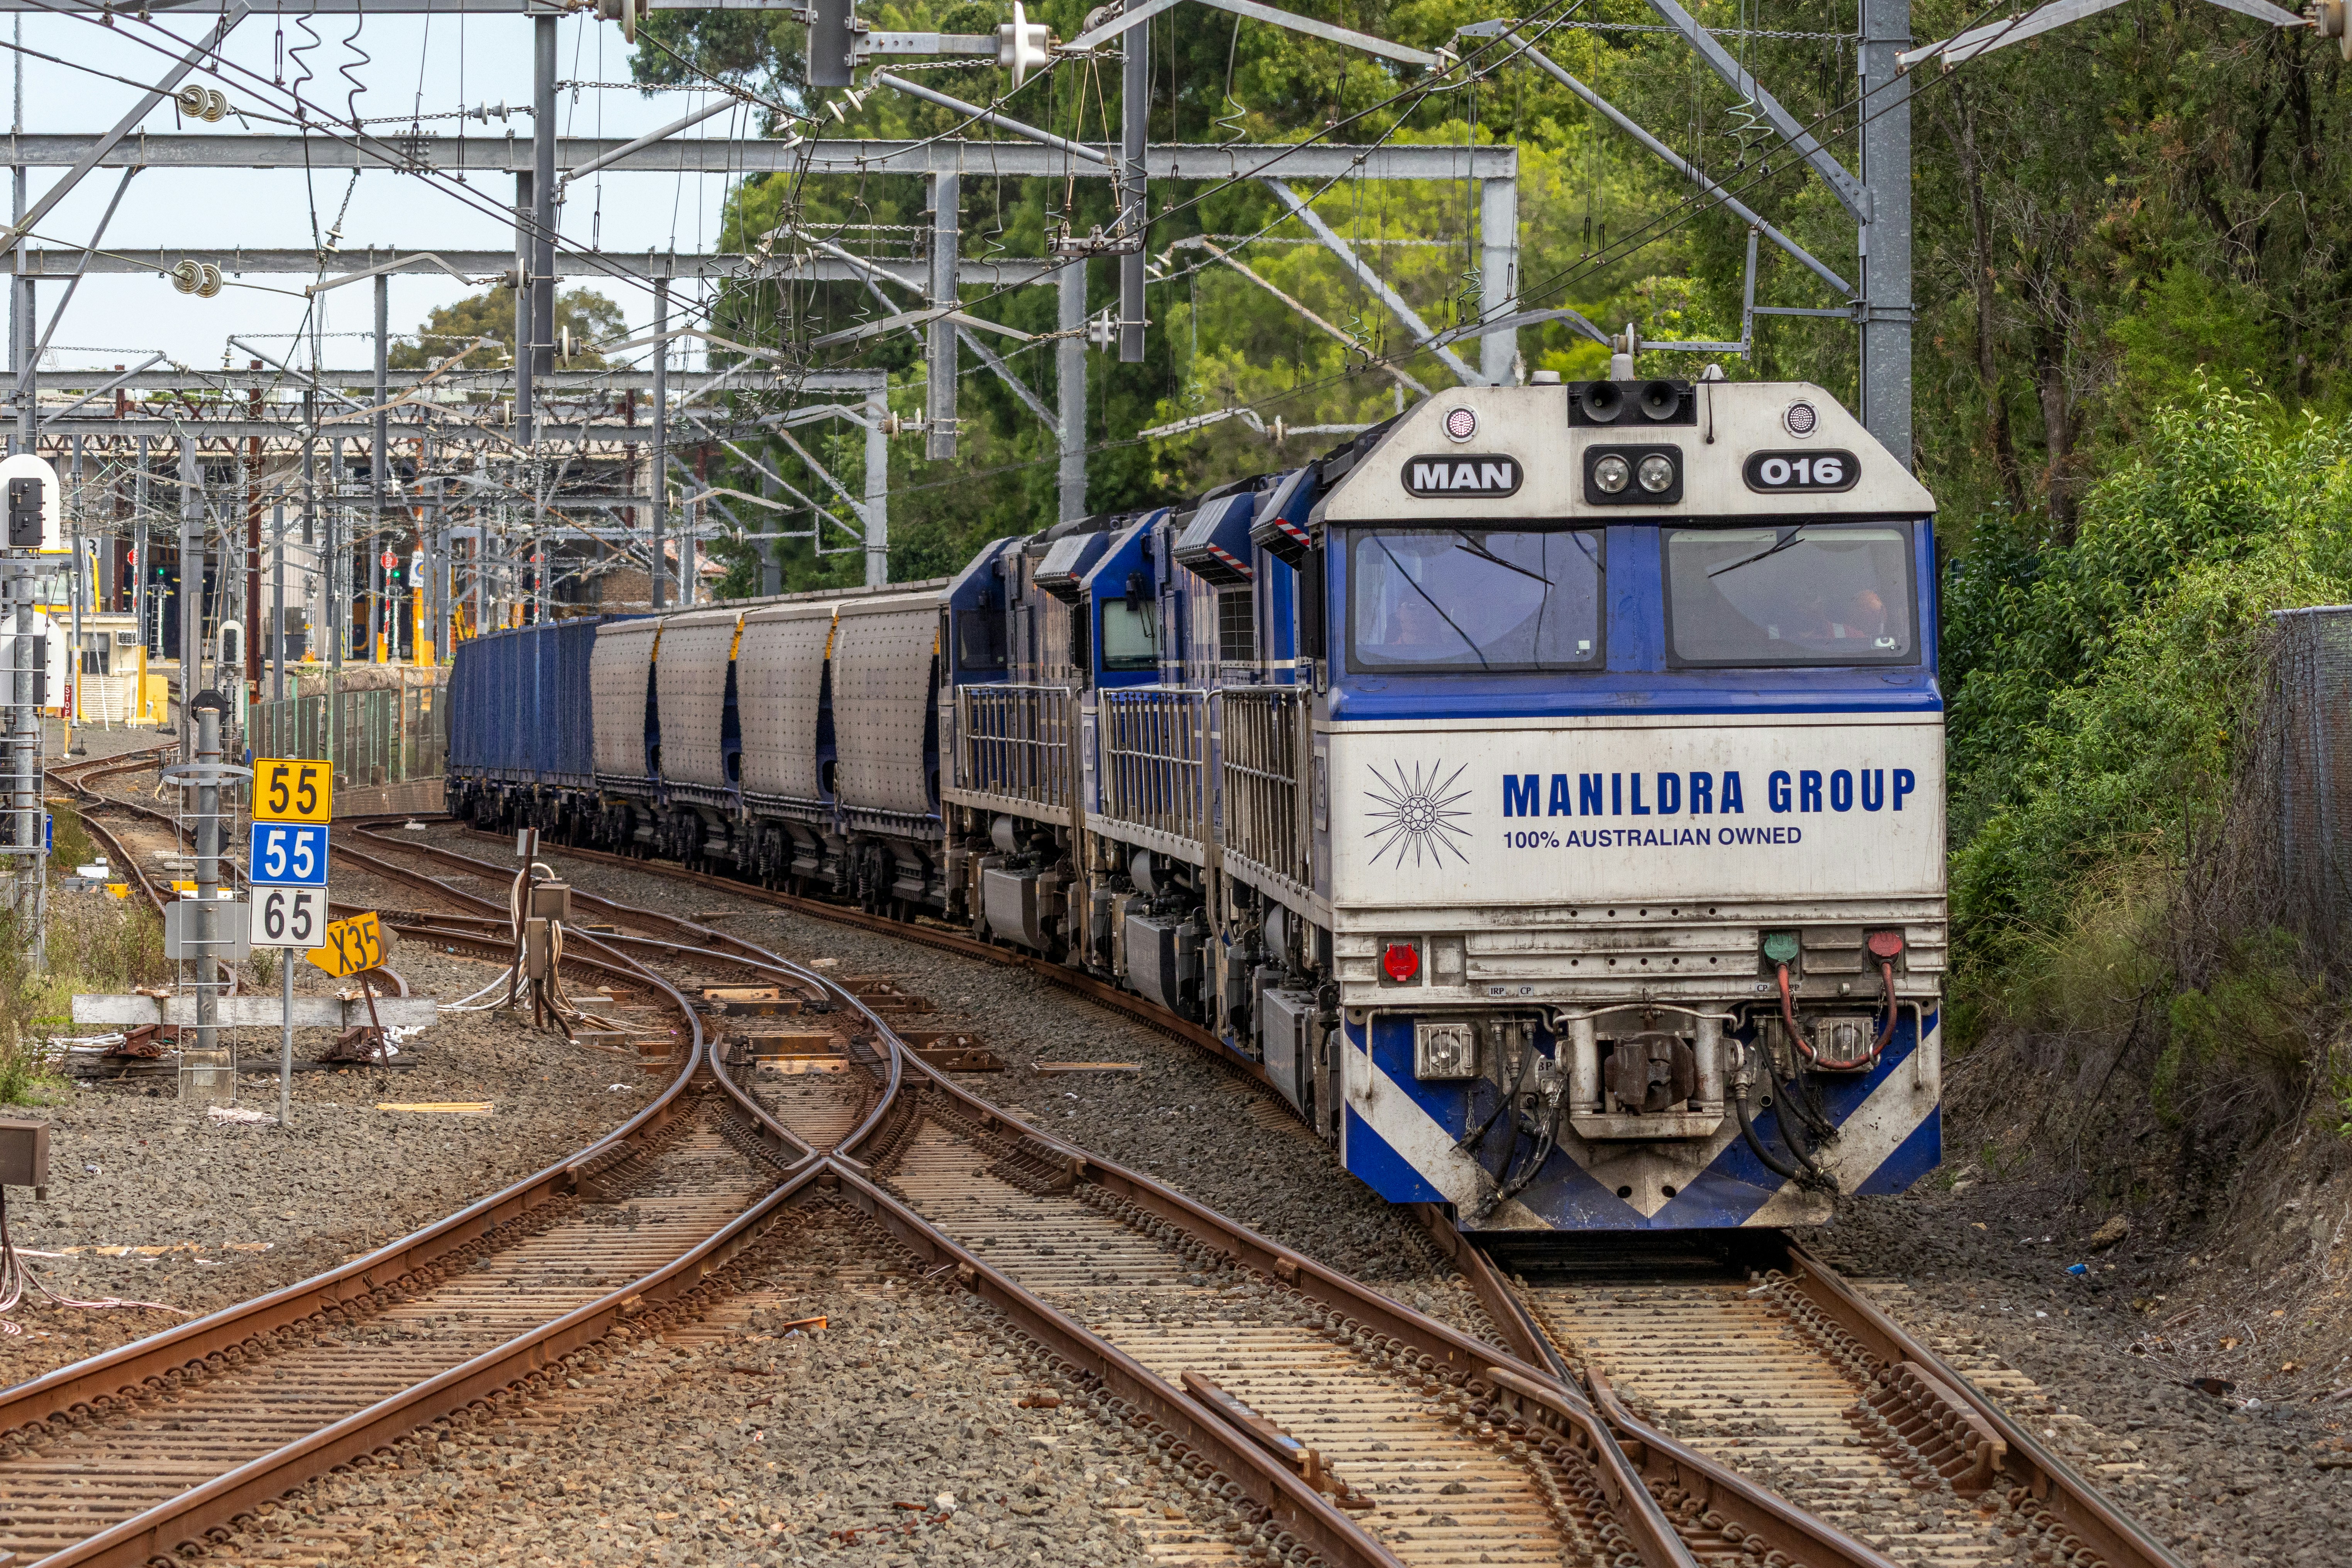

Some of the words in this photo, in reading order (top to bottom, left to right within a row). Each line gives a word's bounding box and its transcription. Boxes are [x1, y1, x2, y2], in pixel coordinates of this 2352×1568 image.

[1413, 463, 1512, 489] MAN
[1761, 458, 1842, 485] 016
[269, 767, 317, 815] 55
[1503, 771, 1744, 817] MANILDRA
[1768, 769, 1915, 813] GROUP
[265, 830, 314, 878] 55
[1503, 831, 1560, 848] 100%
[1566, 828, 1711, 847] AUSTRALIAN
[1718, 827, 1802, 845] OWNED
[264, 892, 312, 940] 65
[329, 920, 382, 975] X35
[1538, 1062, 1552, 1071] BP
